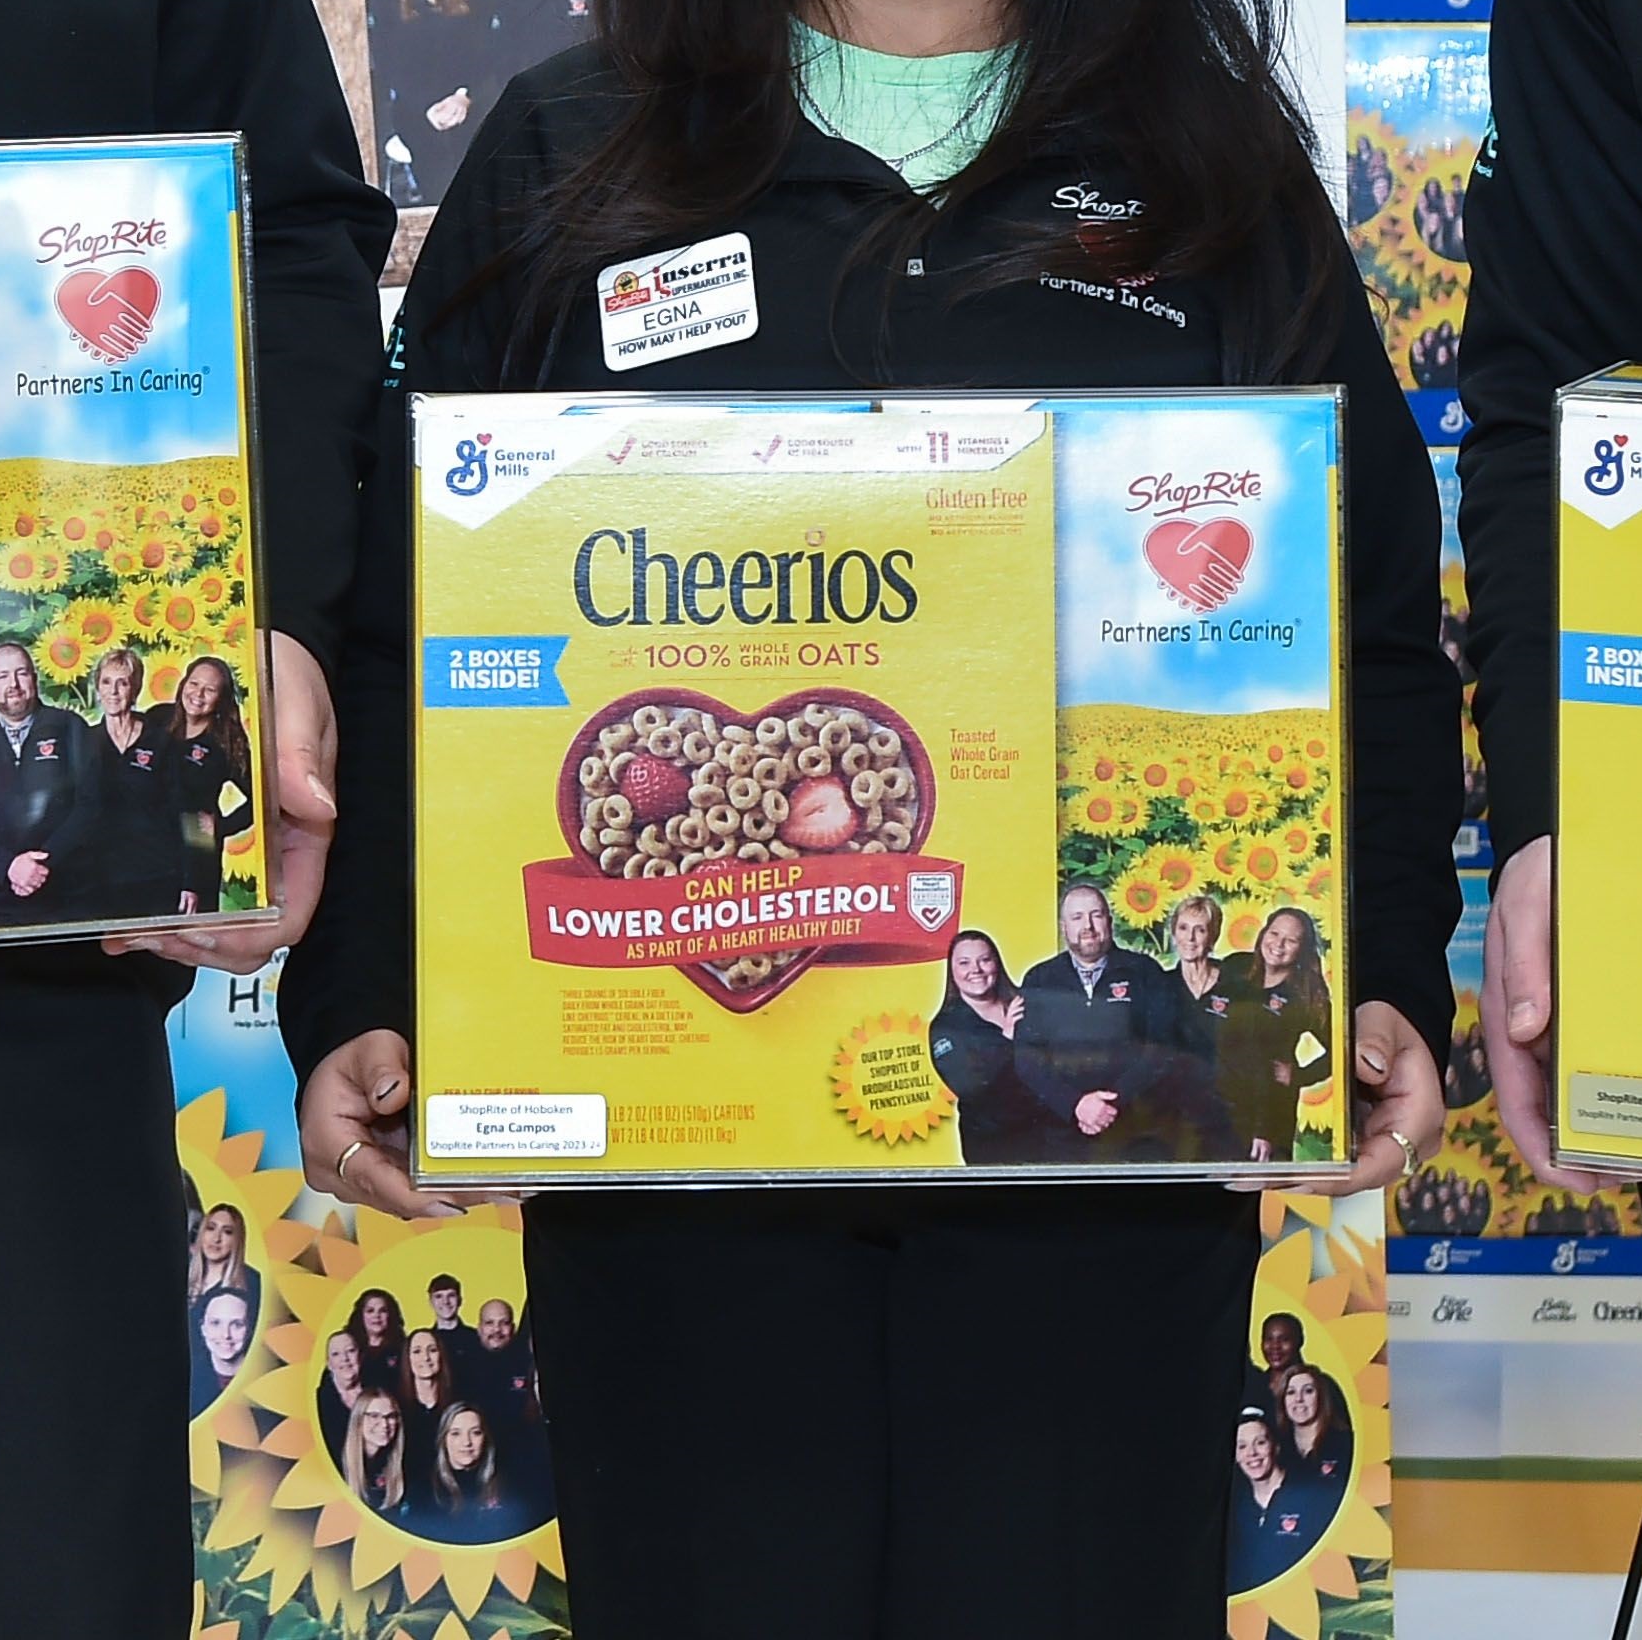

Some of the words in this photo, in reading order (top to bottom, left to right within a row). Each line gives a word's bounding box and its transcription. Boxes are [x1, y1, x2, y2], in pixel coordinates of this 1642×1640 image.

[36, 218, 167, 267] ShopRite
[659, 272, 730, 299] SUPERMARKETS
[1039, 271, 1115, 303] Partners
[1120, 288, 1140, 308] In
[1143, 296, 1186, 327] Caring
[619, 340, 647, 356] HOW
[651, 333, 675, 348] MAY
[686, 323, 712, 338] HELP
[715, 314, 747, 330] YOU?
[643, 301, 702, 331] EGNA
[17, 372, 103, 396] Partners
[110, 371, 133, 391] In
[1125, 470, 1261, 516] ShopRite
[573, 528, 918, 628] Cheerios
[1101, 620, 1191, 642] Partners
[1198, 620, 1222, 641] In
[548, 906, 663, 937] LOWER
[671, 886, 897, 931] CHOLESTEROL
[476, 1122, 505, 1136] Egna
[509, 1121, 555, 1136] Campos
